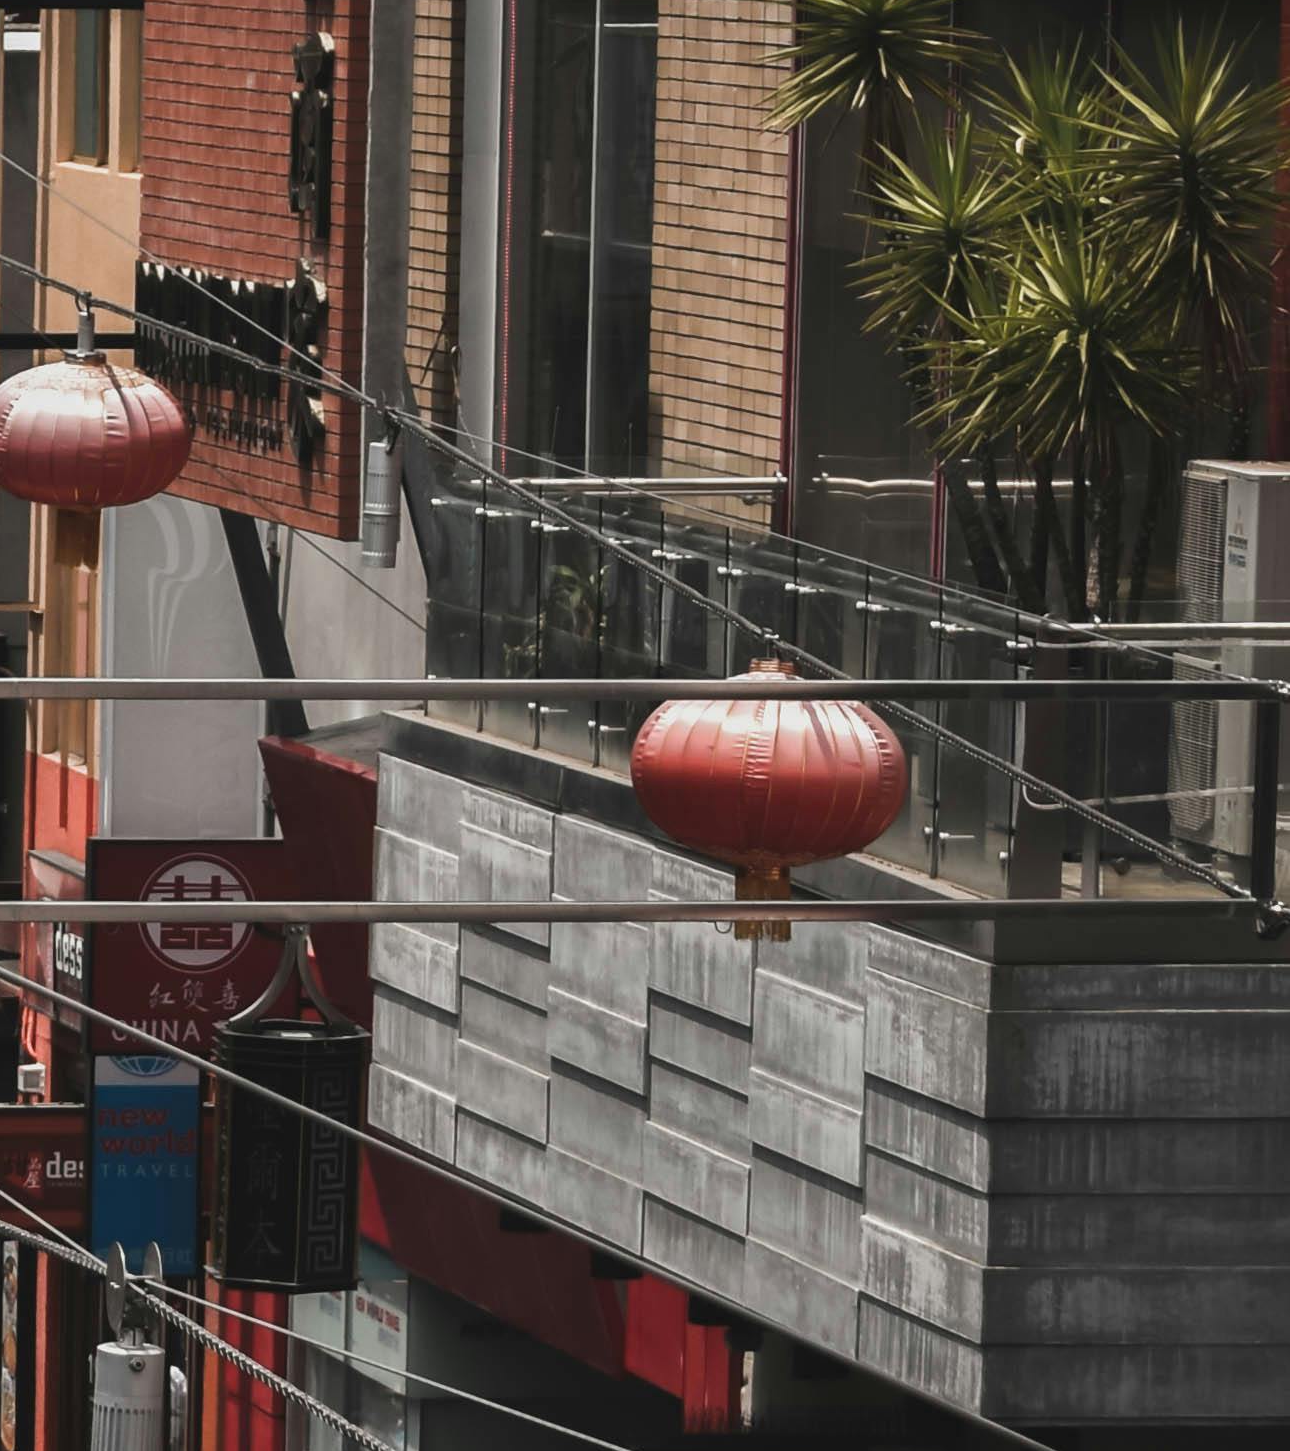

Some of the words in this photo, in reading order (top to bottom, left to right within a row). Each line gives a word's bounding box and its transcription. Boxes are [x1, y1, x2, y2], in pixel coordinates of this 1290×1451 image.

[110, 1020, 202, 1044] CHINA
[98, 1107, 167, 1127] new
[101, 1128, 197, 1157] world
[100, 1163, 194, 1179] TRAVEL
